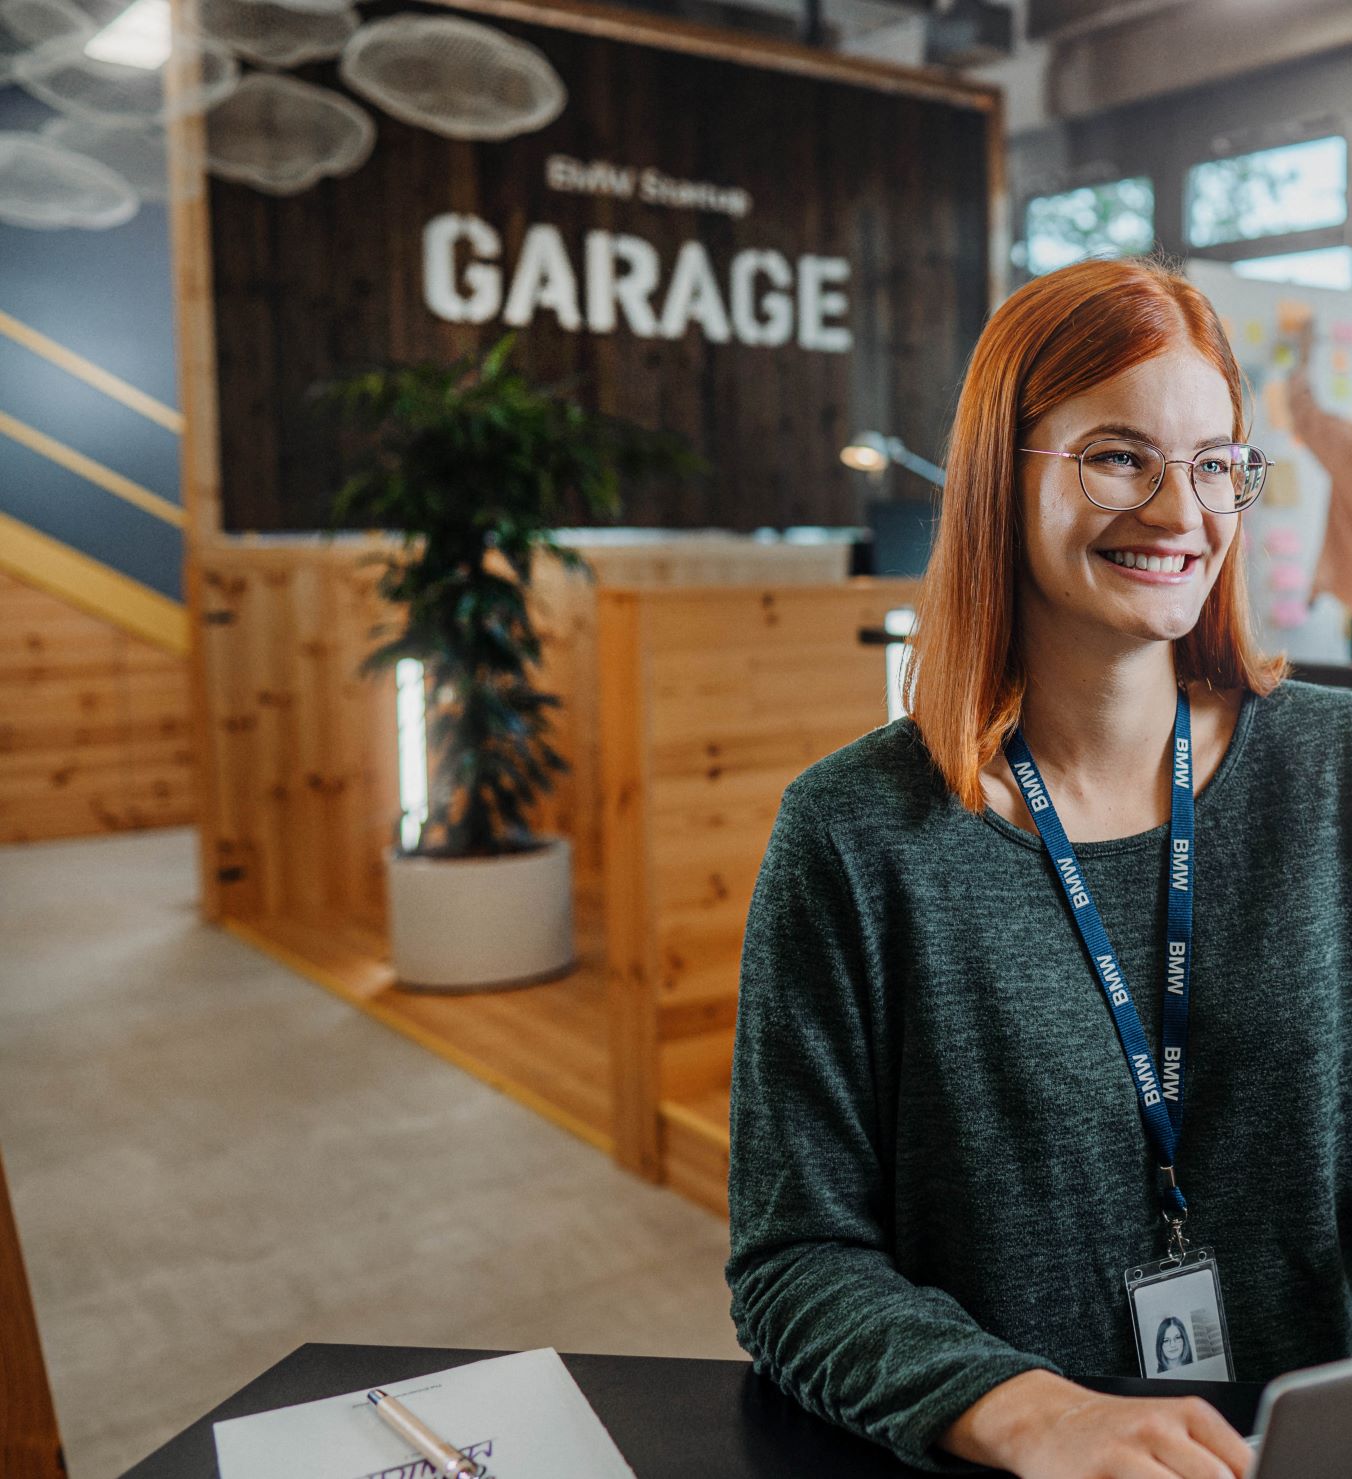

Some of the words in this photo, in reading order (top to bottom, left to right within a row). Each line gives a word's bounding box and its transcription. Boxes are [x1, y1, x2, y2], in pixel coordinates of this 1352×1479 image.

[546, 154, 635, 197] BMW
[639, 167, 751, 217] Startup
[422, 212, 853, 353] GARAGE
[1014, 761, 1050, 813] BMW
[1174, 737, 1190, 789] BMW
[1057, 857, 1090, 909] BMW
[1172, 838, 1190, 892] BMW
[1096, 954, 1129, 1007] BMW
[1167, 941, 1186, 995] BMW
[1132, 1053, 1161, 1107] BMW
[1162, 1046, 1181, 1101] BMW
